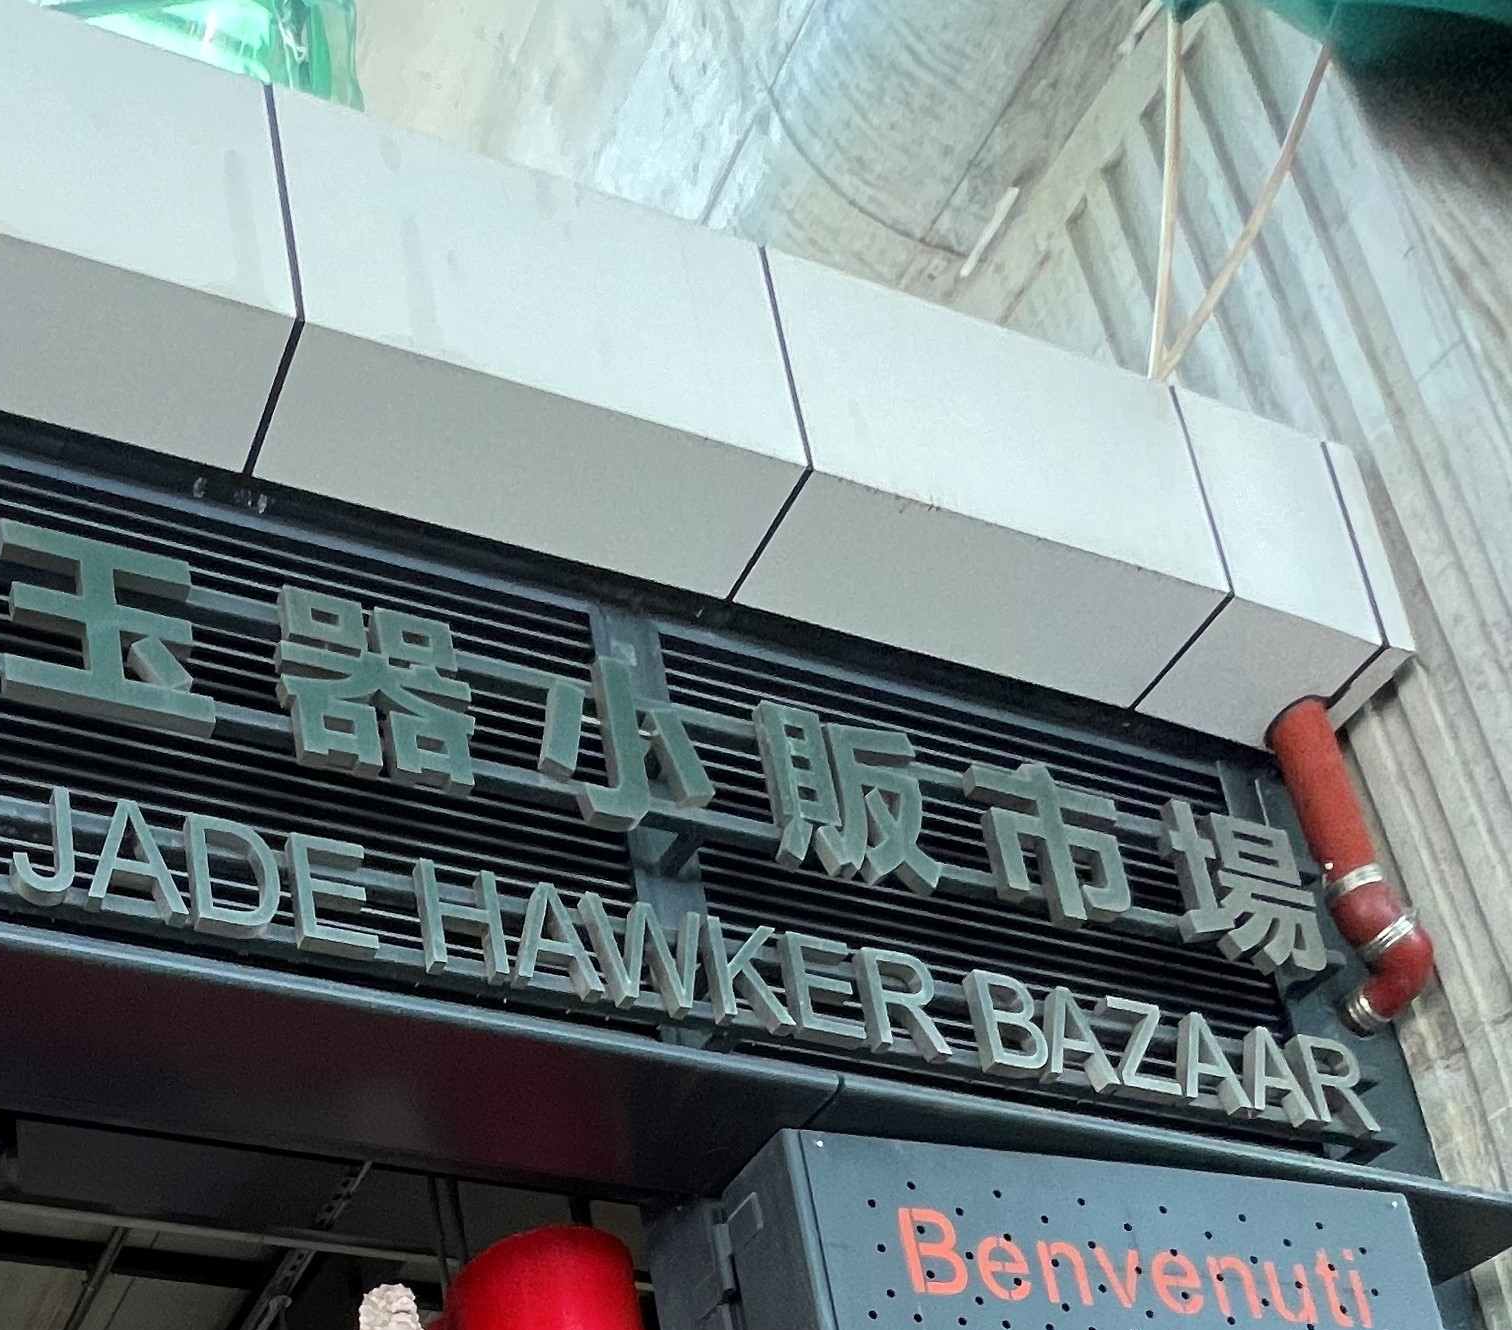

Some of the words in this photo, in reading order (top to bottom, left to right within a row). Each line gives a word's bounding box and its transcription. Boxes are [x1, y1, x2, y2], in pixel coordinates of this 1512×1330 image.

[10, 786, 380, 959] JADE
[413, 857, 954, 1064] HAWKER
[963, 968, 1382, 1139] BAZAAR
[897, 1206, 1375, 1329] Benvenuti
